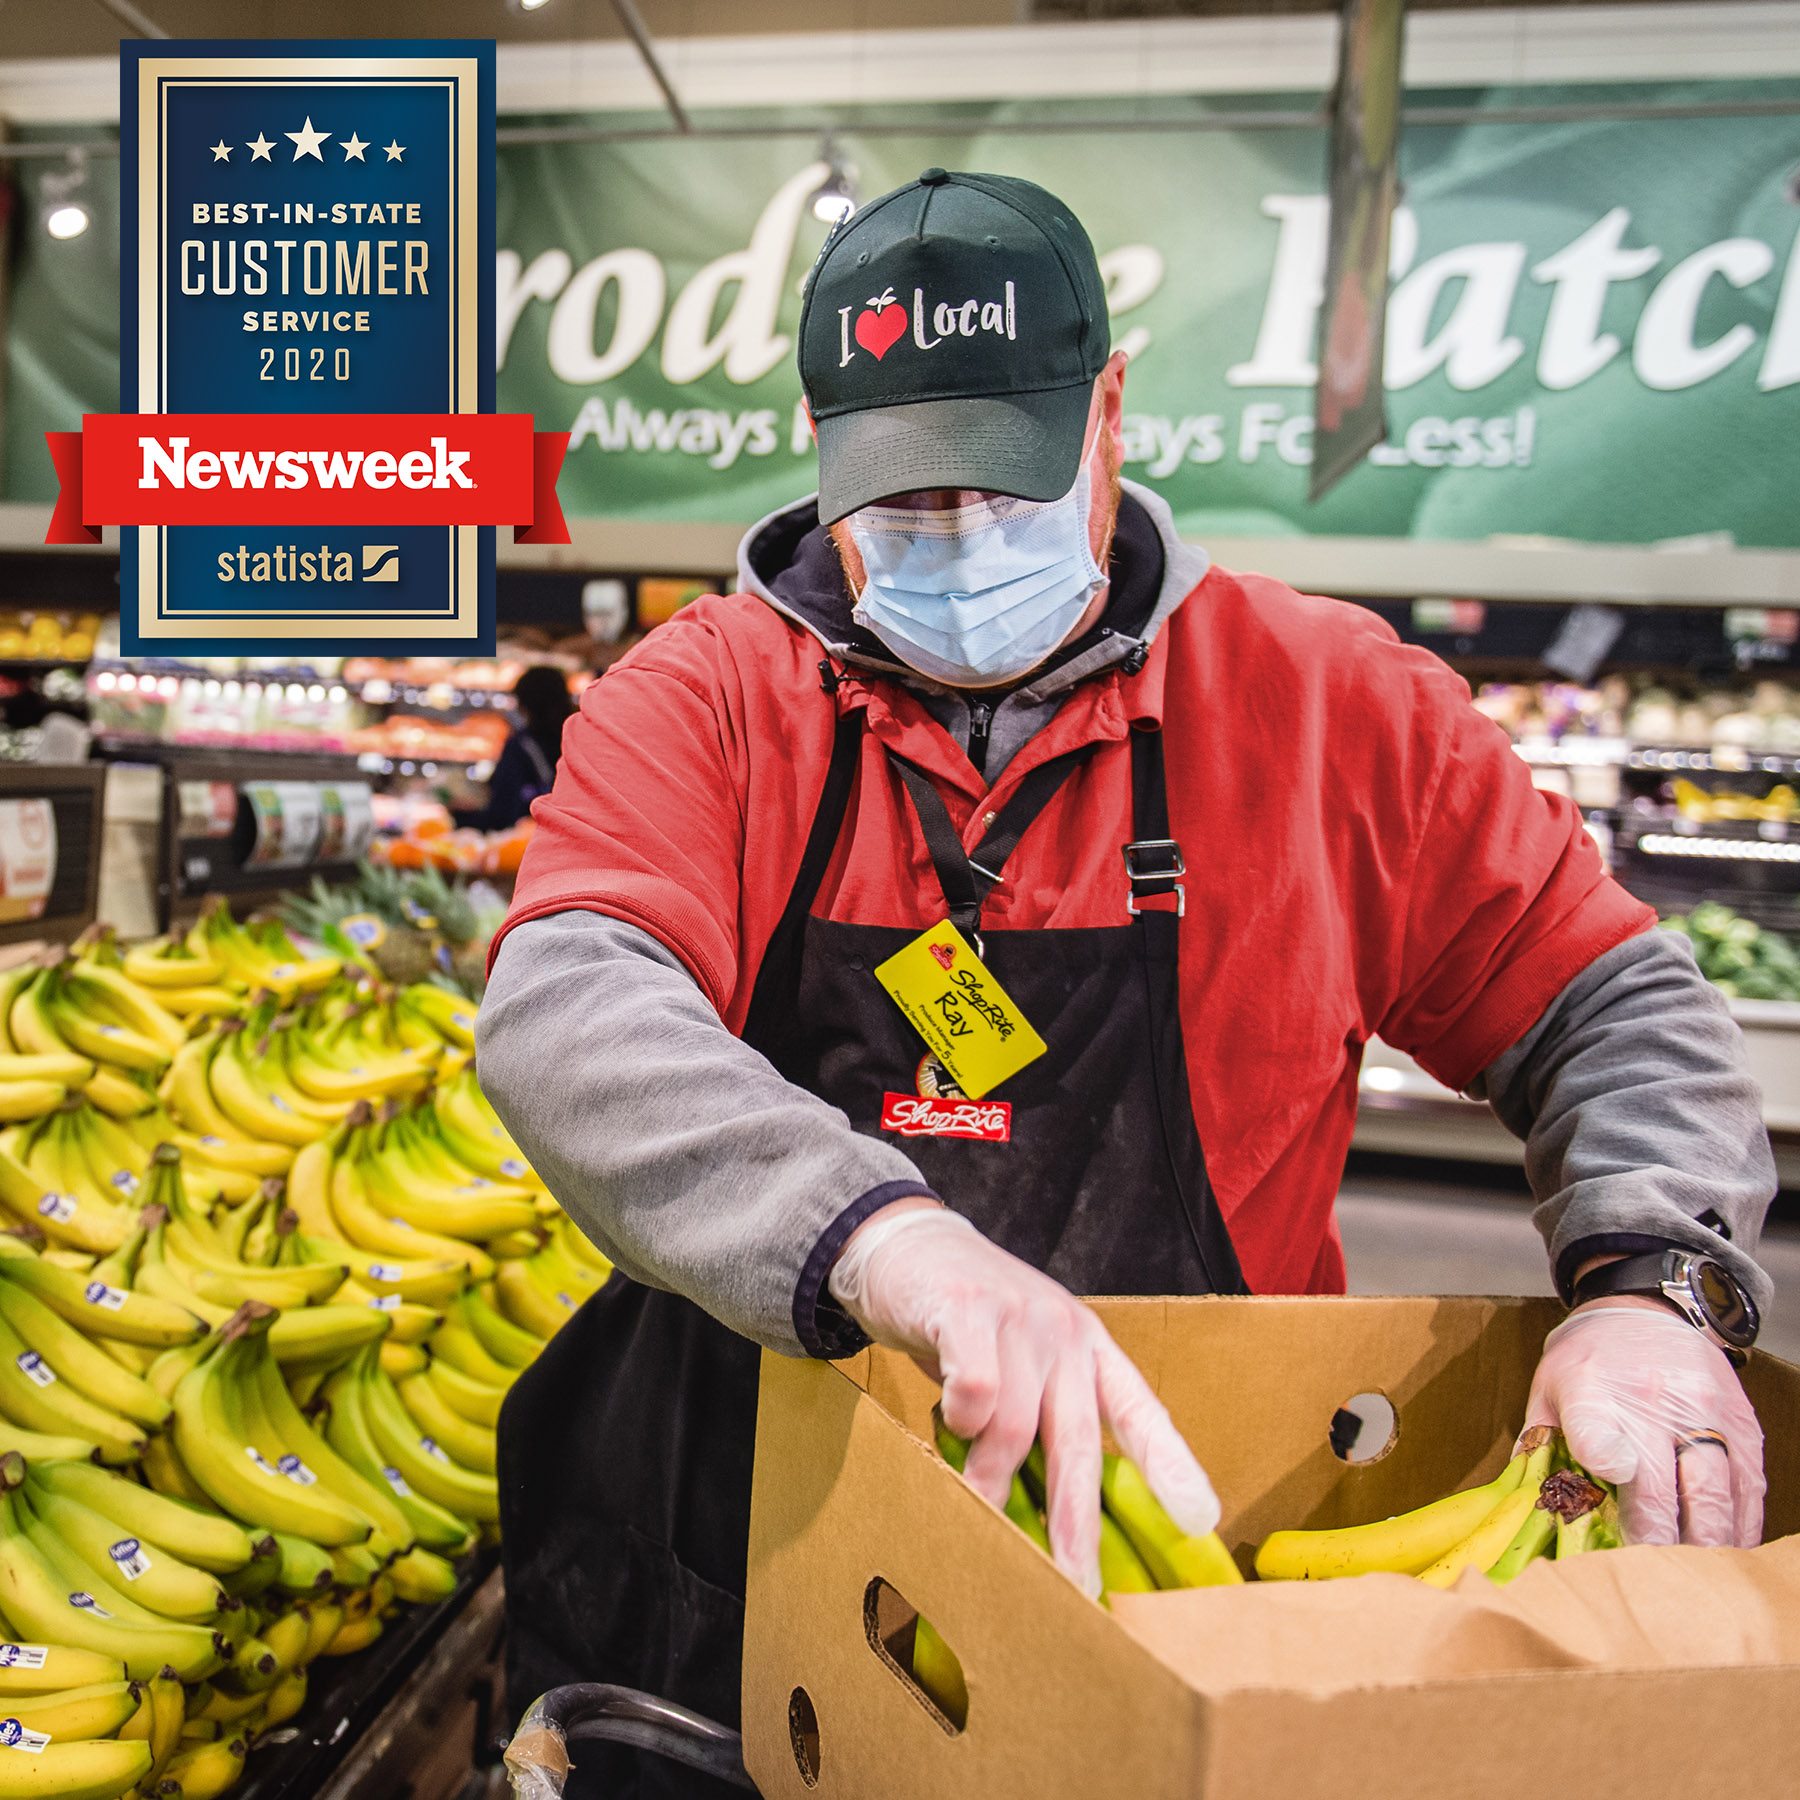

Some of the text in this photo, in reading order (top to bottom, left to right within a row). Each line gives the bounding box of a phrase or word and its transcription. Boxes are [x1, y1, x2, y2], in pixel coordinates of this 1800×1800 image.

[838, 280, 1016, 367] I Local
[567, 396, 778, 468] Always
[934, 991, 974, 1037] Ray
[949, 969, 1015, 1037] ShopRite
[884, 1100, 1006, 1140] ShopRite
